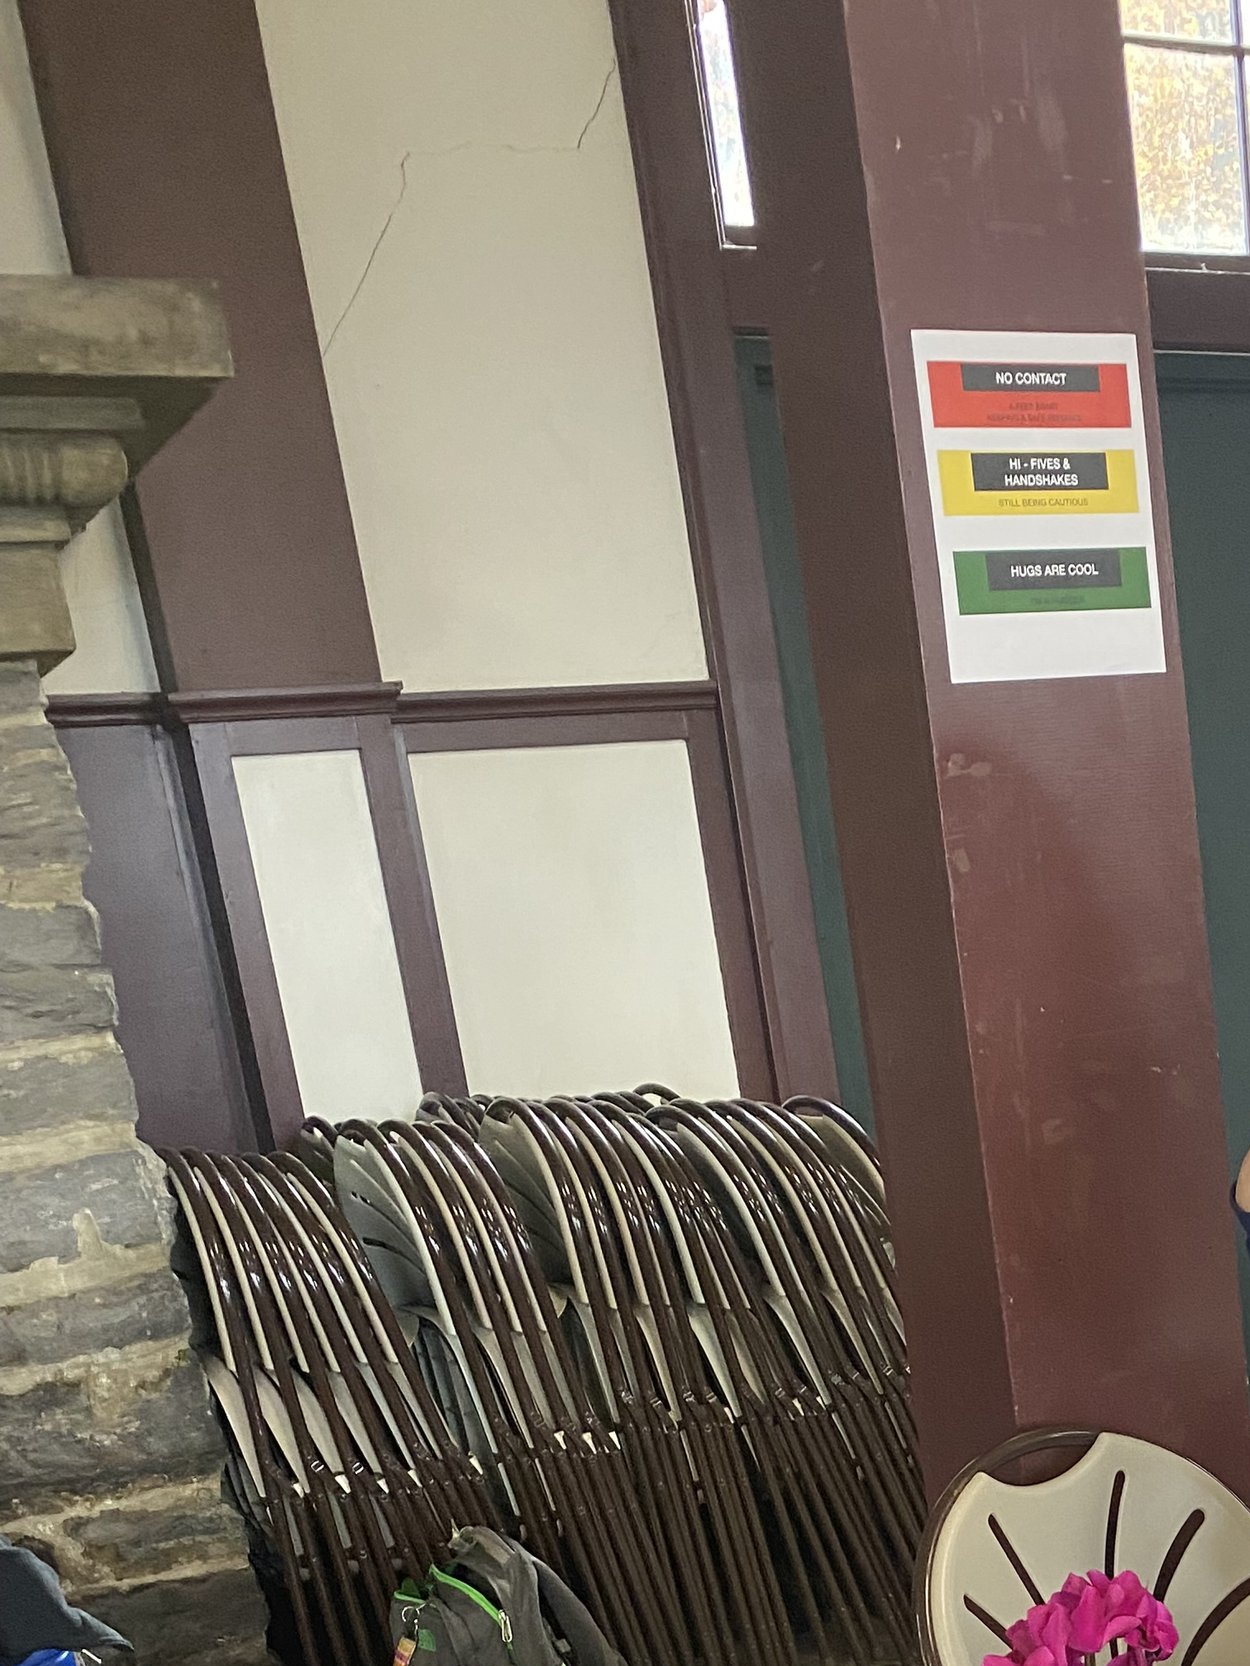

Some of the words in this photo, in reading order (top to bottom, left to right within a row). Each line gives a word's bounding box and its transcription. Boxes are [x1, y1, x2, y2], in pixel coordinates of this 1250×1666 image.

[996, 372, 1014, 384] NO
[1016, 373, 1067, 386] CONTACT
[1009, 459, 1021, 470] HI
[1031, 458, 1060, 470] FIVES
[1063, 458, 1071, 469] &
[1005, 474, 1078, 486] HANDSHAKES
[999, 498, 1019, 507] STILL
[1022, 498, 1047, 507] BEING
[1049, 498, 1088, 506] CAUTIOUS
[1011, 565, 1041, 577] HUGS
[1045, 564, 1067, 576] ARE
[1069, 564, 1099, 576] COOL
